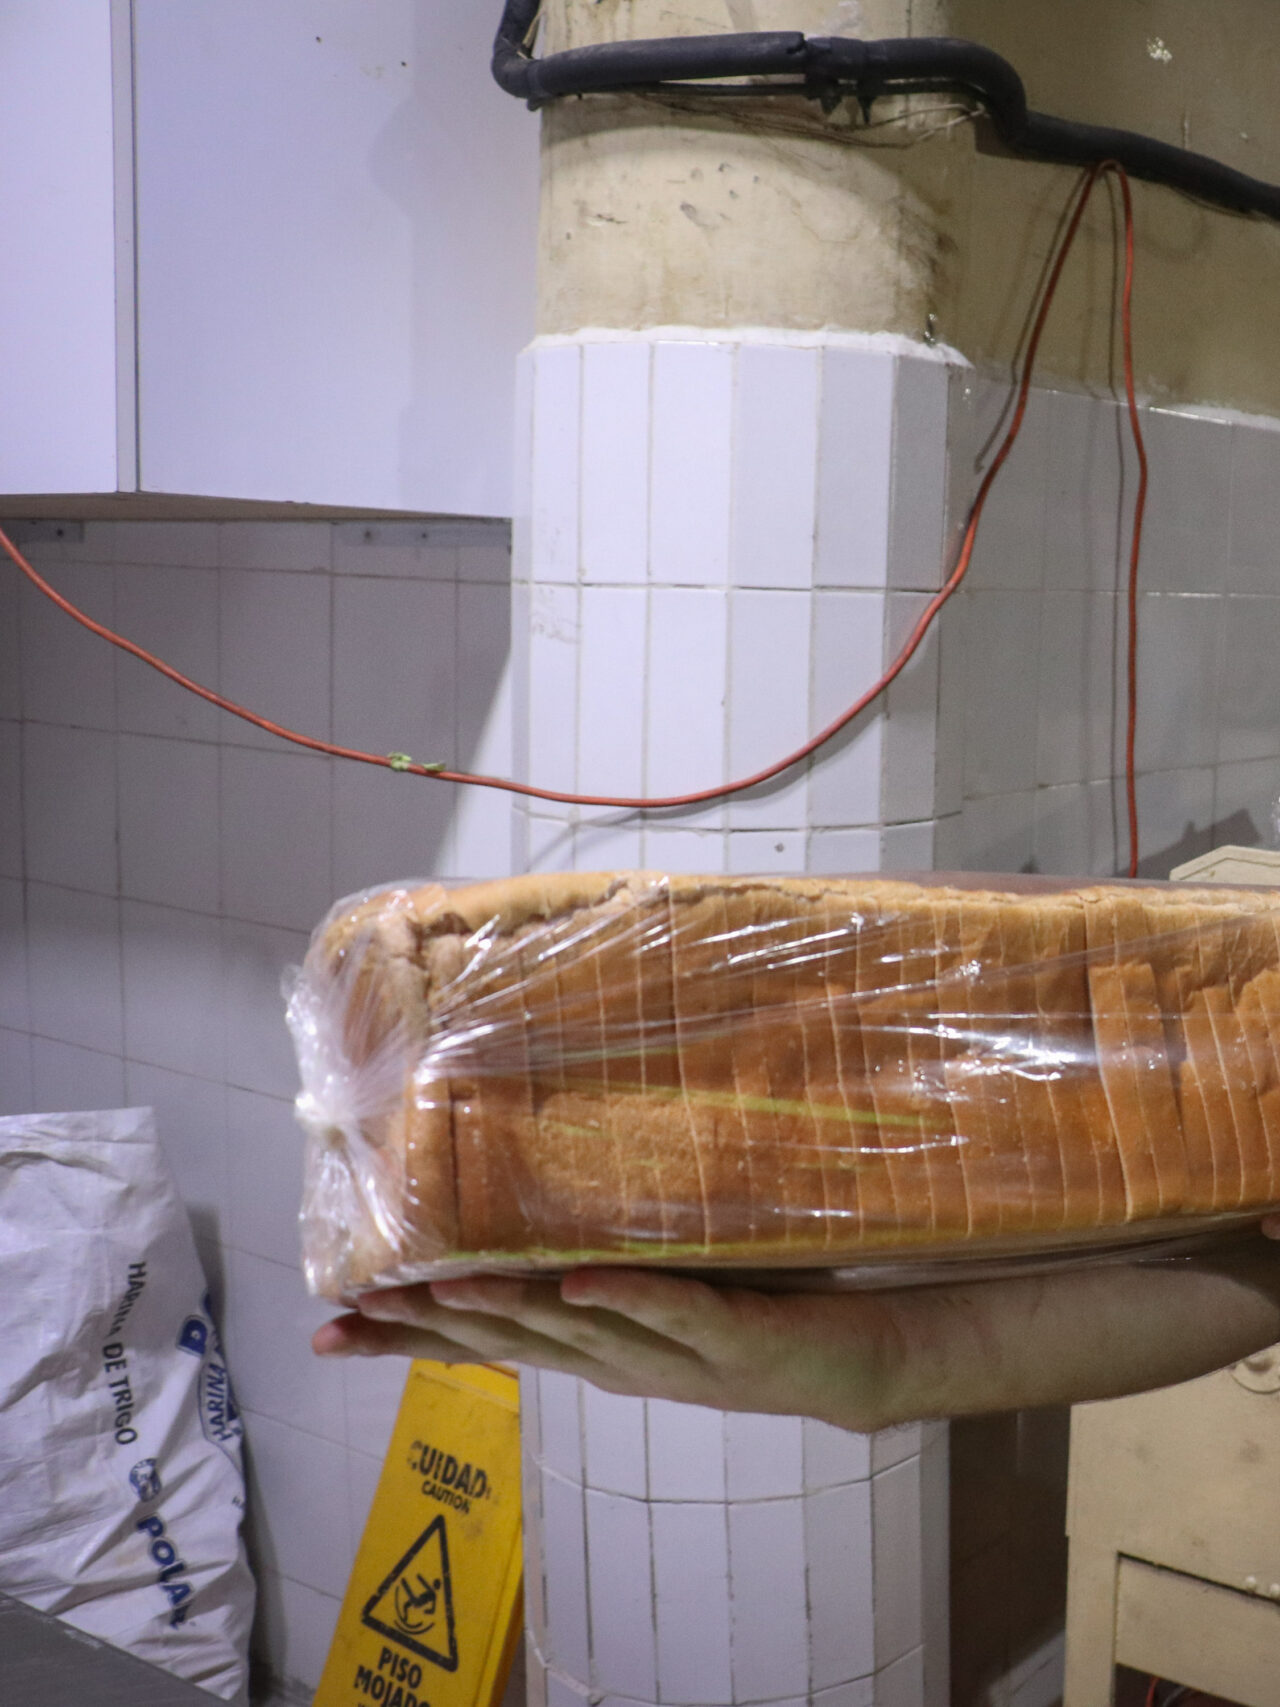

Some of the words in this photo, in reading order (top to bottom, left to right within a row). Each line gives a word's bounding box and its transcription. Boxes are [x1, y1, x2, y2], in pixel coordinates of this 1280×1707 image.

[103, 1342, 127, 1373] DE
[109, 1376, 138, 1445] TRIGO
[207, 1362, 233, 1441] HARINA
[422, 1481, 470, 1515] CAUTION
[378, 1647, 422, 1689] PISO
